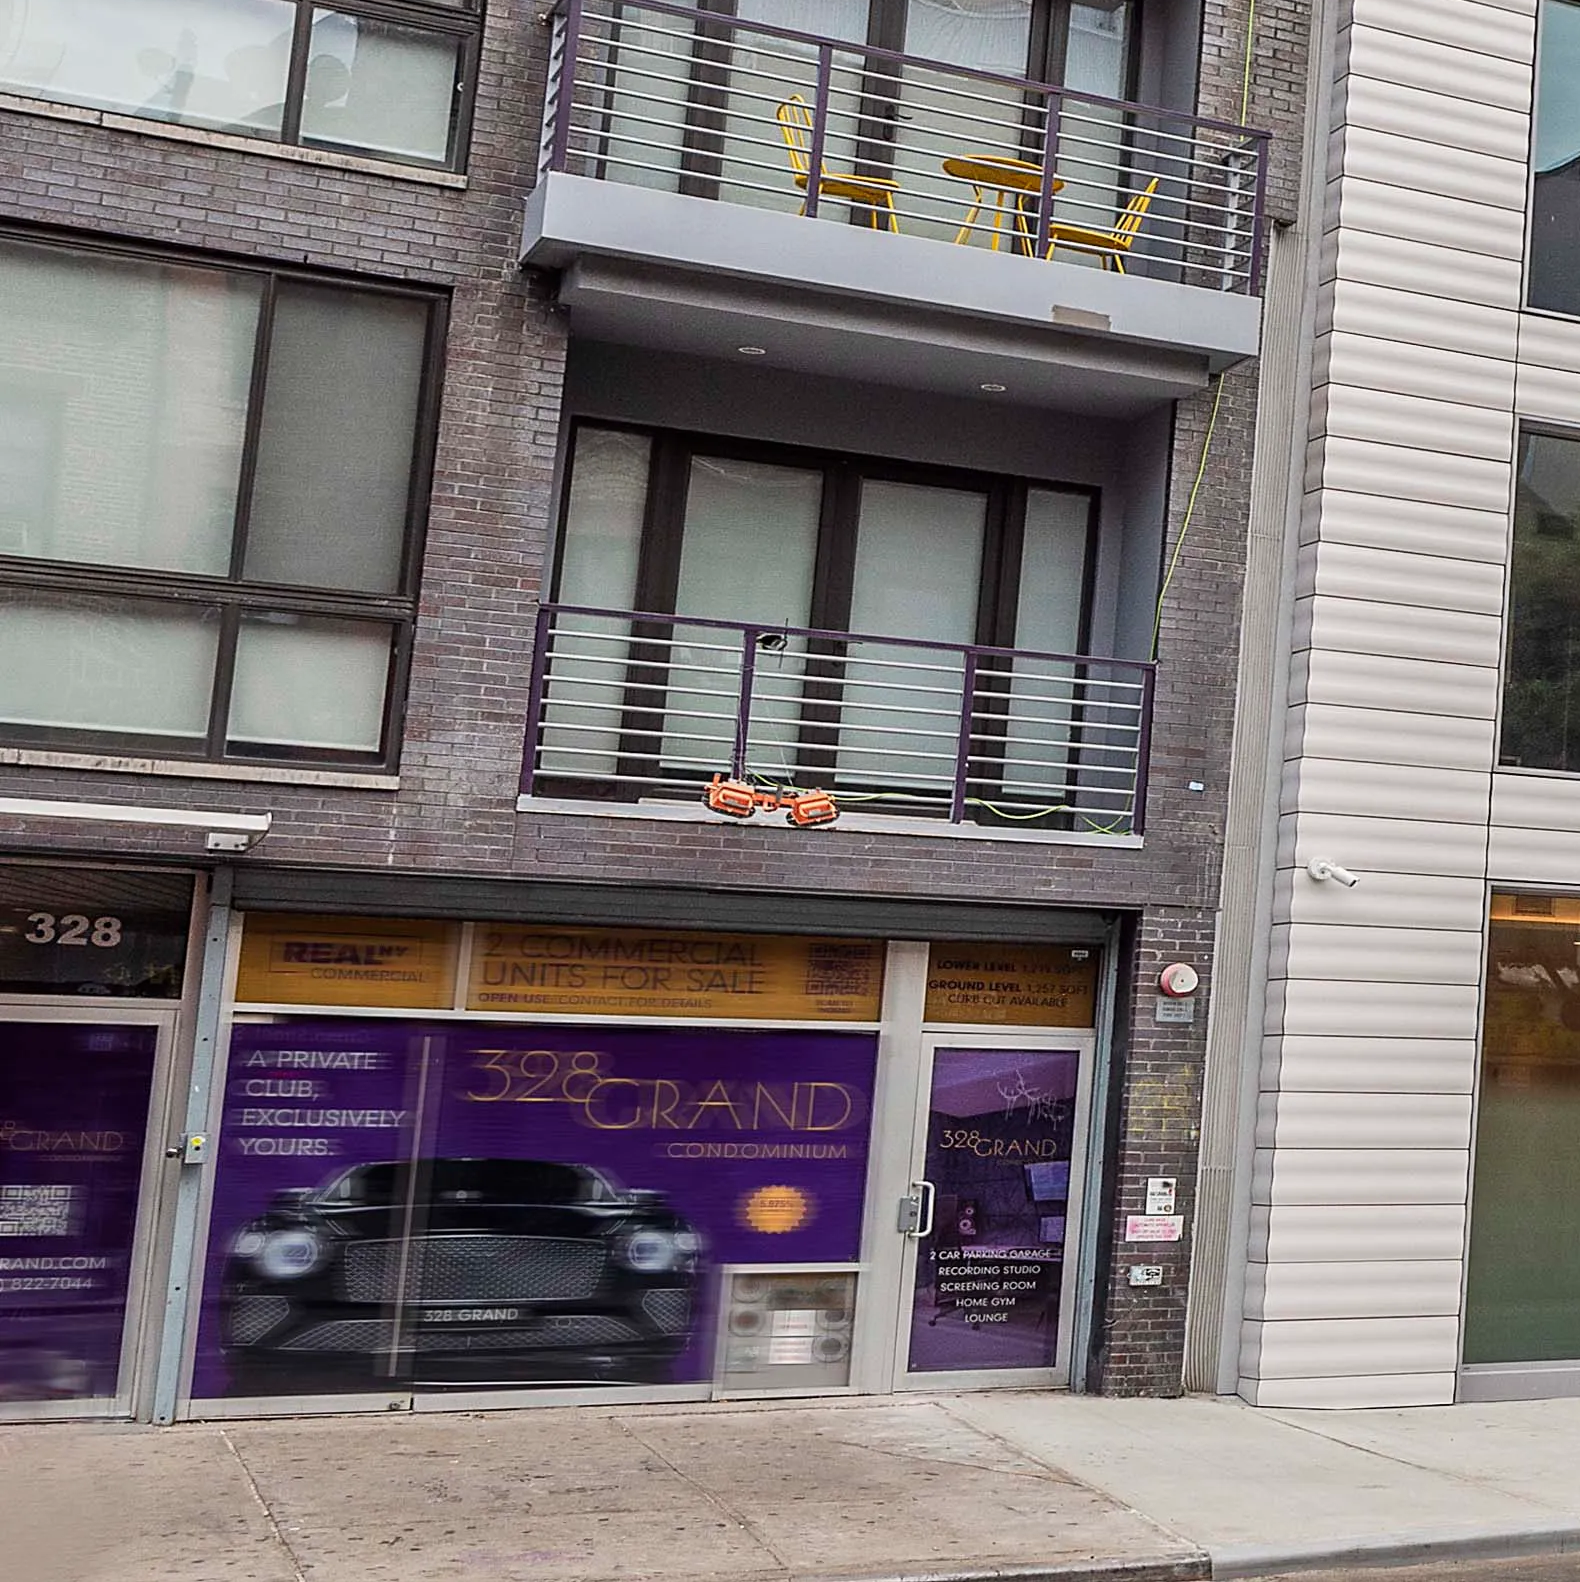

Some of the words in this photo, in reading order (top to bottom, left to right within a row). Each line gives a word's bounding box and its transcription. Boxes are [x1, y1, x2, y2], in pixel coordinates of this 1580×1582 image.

[25, 912, 122, 947] 328
[485, 932, 504, 957] 2
[521, 934, 763, 967] COMMERCIAL
[310, 968, 425, 983] COMMERCIAL
[483, 961, 586, 988] UNITS
[602, 965, 672, 991] FOR
[687, 969, 765, 995] SALE
[928, 979, 985, 991] GROUND
[989, 982, 1022, 992] LEVEL
[479, 992, 518, 1003] OPEN
[247, 1050, 267, 1067] A
[276, 1051, 379, 1070] PRIVATE
[467, 1049, 601, 1104] 328
[245, 1079, 320, 1102] CLUB,
[585, 1079, 852, 1131] GRAND
[241, 1108, 407, 1127] EXCLUSIVELY
[9, 1130, 124, 1151] GRAND
[238, 1138, 336, 1156] YOURS.
[940, 1130, 980, 1148] 328
[974, 1139, 1057, 1157] GRAND
[667, 1143, 848, 1160] CONDOMINIUM
[930, 1251, 936, 1261] 2
[939, 1250, 960, 1260] CAR
[963, 1249, 1007, 1259] PARKING
[1009, 1249, 1051, 1259] GARAGE
[938, 1266, 1000, 1276] RECORDING
[1003, 1265, 1041, 1275] STUDIO
[940, 1282, 1000, 1292] SCREENING
[1003, 1281, 1036, 1291] ROOM
[956, 1298, 989, 1308] HOME
[991, 1297, 1016, 1307] GYM
[424, 1310, 452, 1322] 328
[458, 1308, 518, 1321] GRAND
[965, 1313, 1008, 1323] LOUNGE
